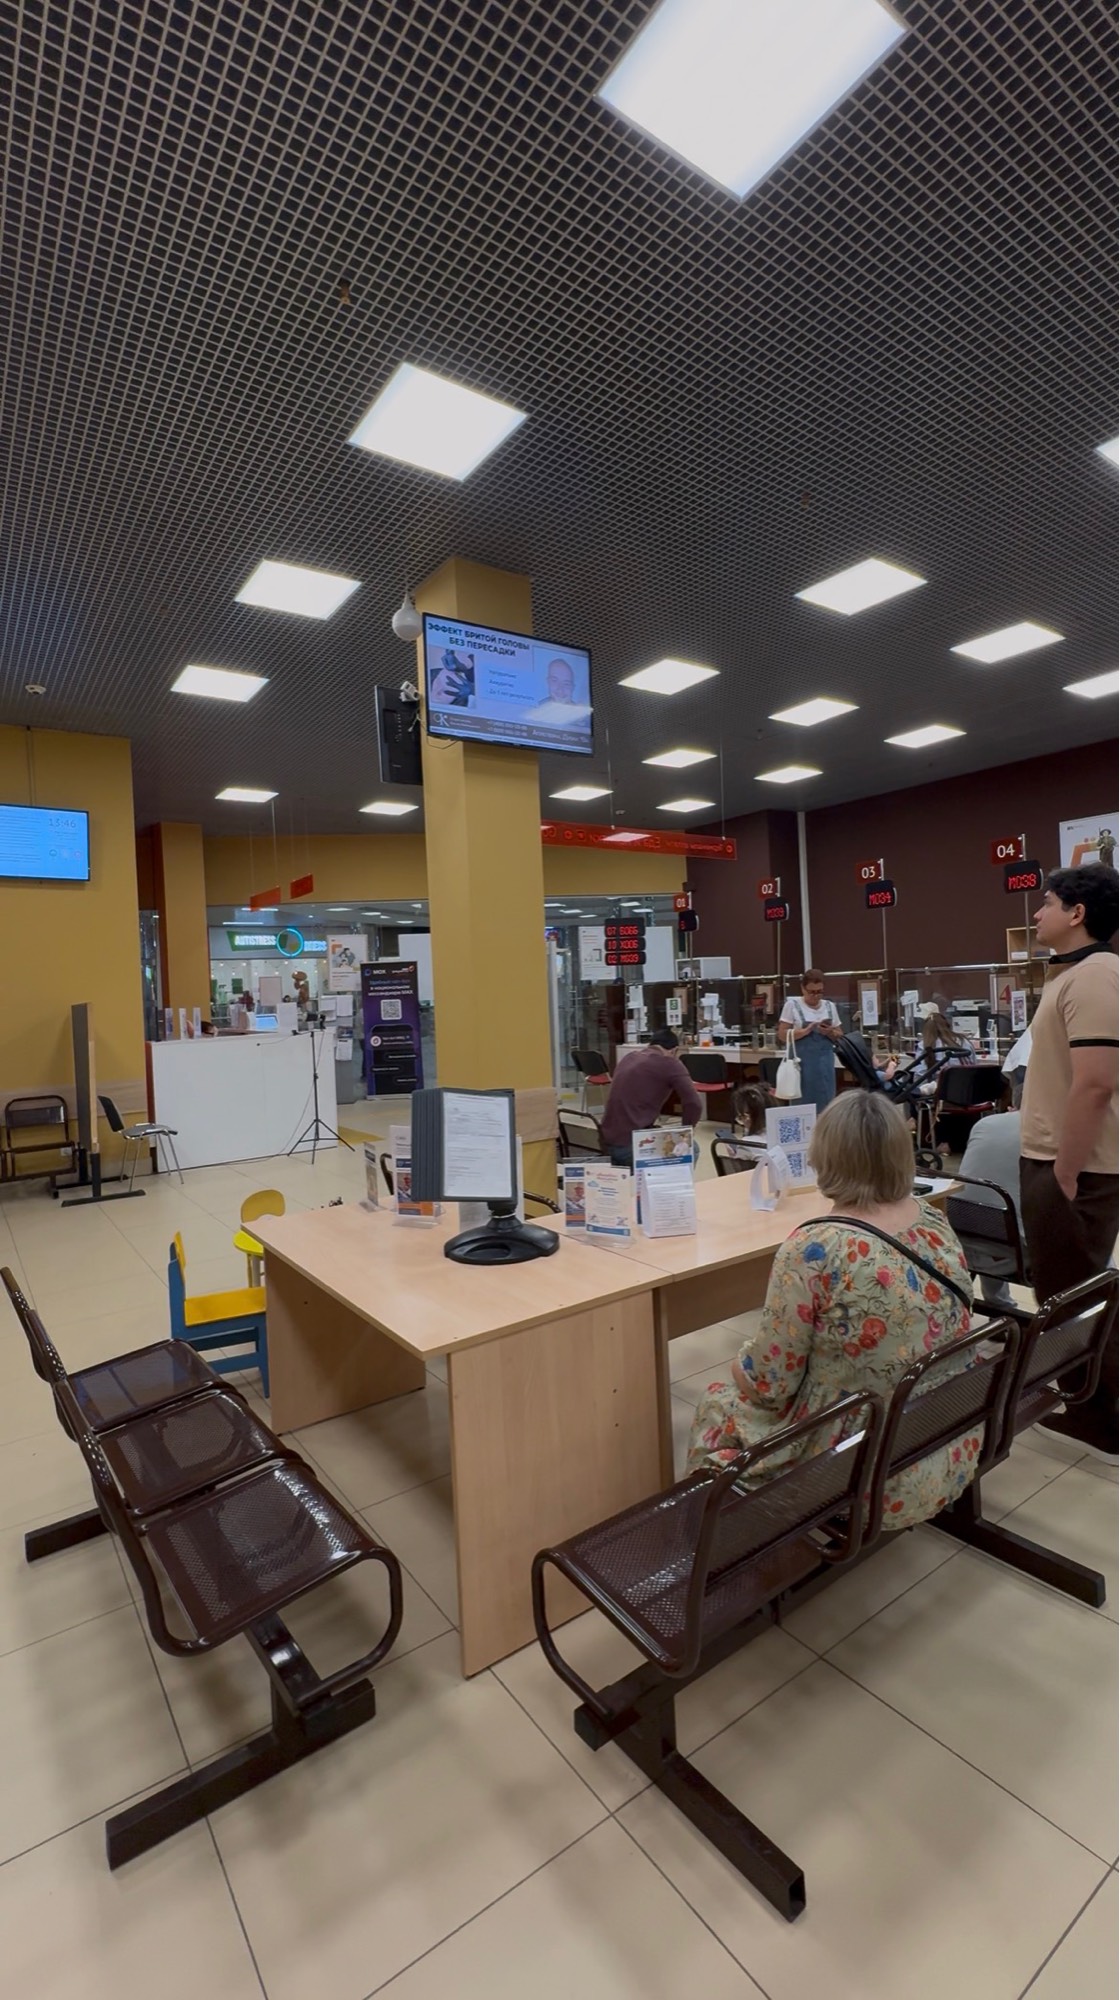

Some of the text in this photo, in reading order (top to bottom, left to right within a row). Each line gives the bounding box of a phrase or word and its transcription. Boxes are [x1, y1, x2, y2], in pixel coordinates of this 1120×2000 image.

[428, 622, 530, 650] ЭФФЕКТ БРИТОЙ ГОЛОВЫ
[449, 637, 516, 656] БЕЗ ПЕРЕСАДКИ
[49, 818, 77, 828] 13:46
[996, 843, 1016, 858] 04
[861, 866, 876, 879] 03
[761, 883, 774, 894] 02
[676, 898, 686, 908] 01
[608, 954, 617, 964] 02
